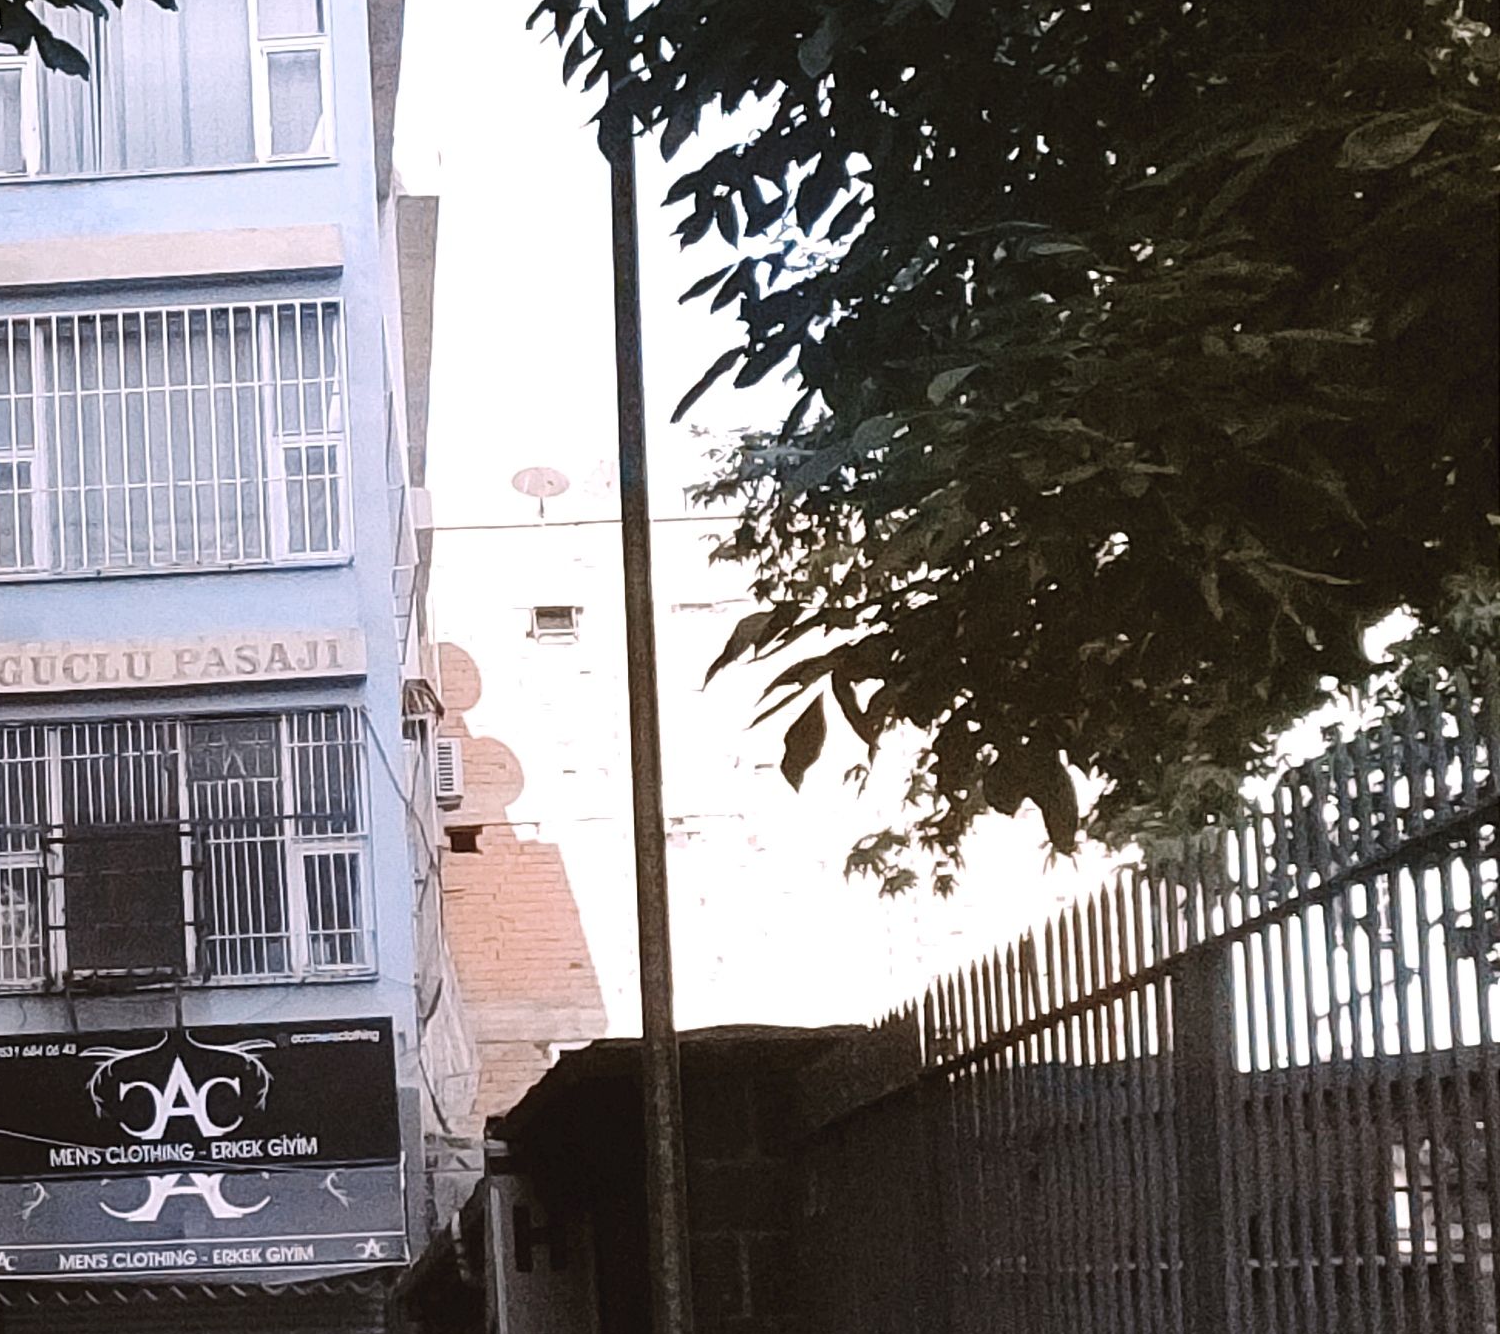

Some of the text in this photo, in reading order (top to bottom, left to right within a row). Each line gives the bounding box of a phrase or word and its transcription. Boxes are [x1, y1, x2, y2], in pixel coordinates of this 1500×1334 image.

[105, 1143, 194, 1164] CLOTHING
[211, 1139, 263, 1159] ERKEK
[112, 1248, 198, 1268] CLOTHING
[213, 1248, 262, 1264] ERKEK
